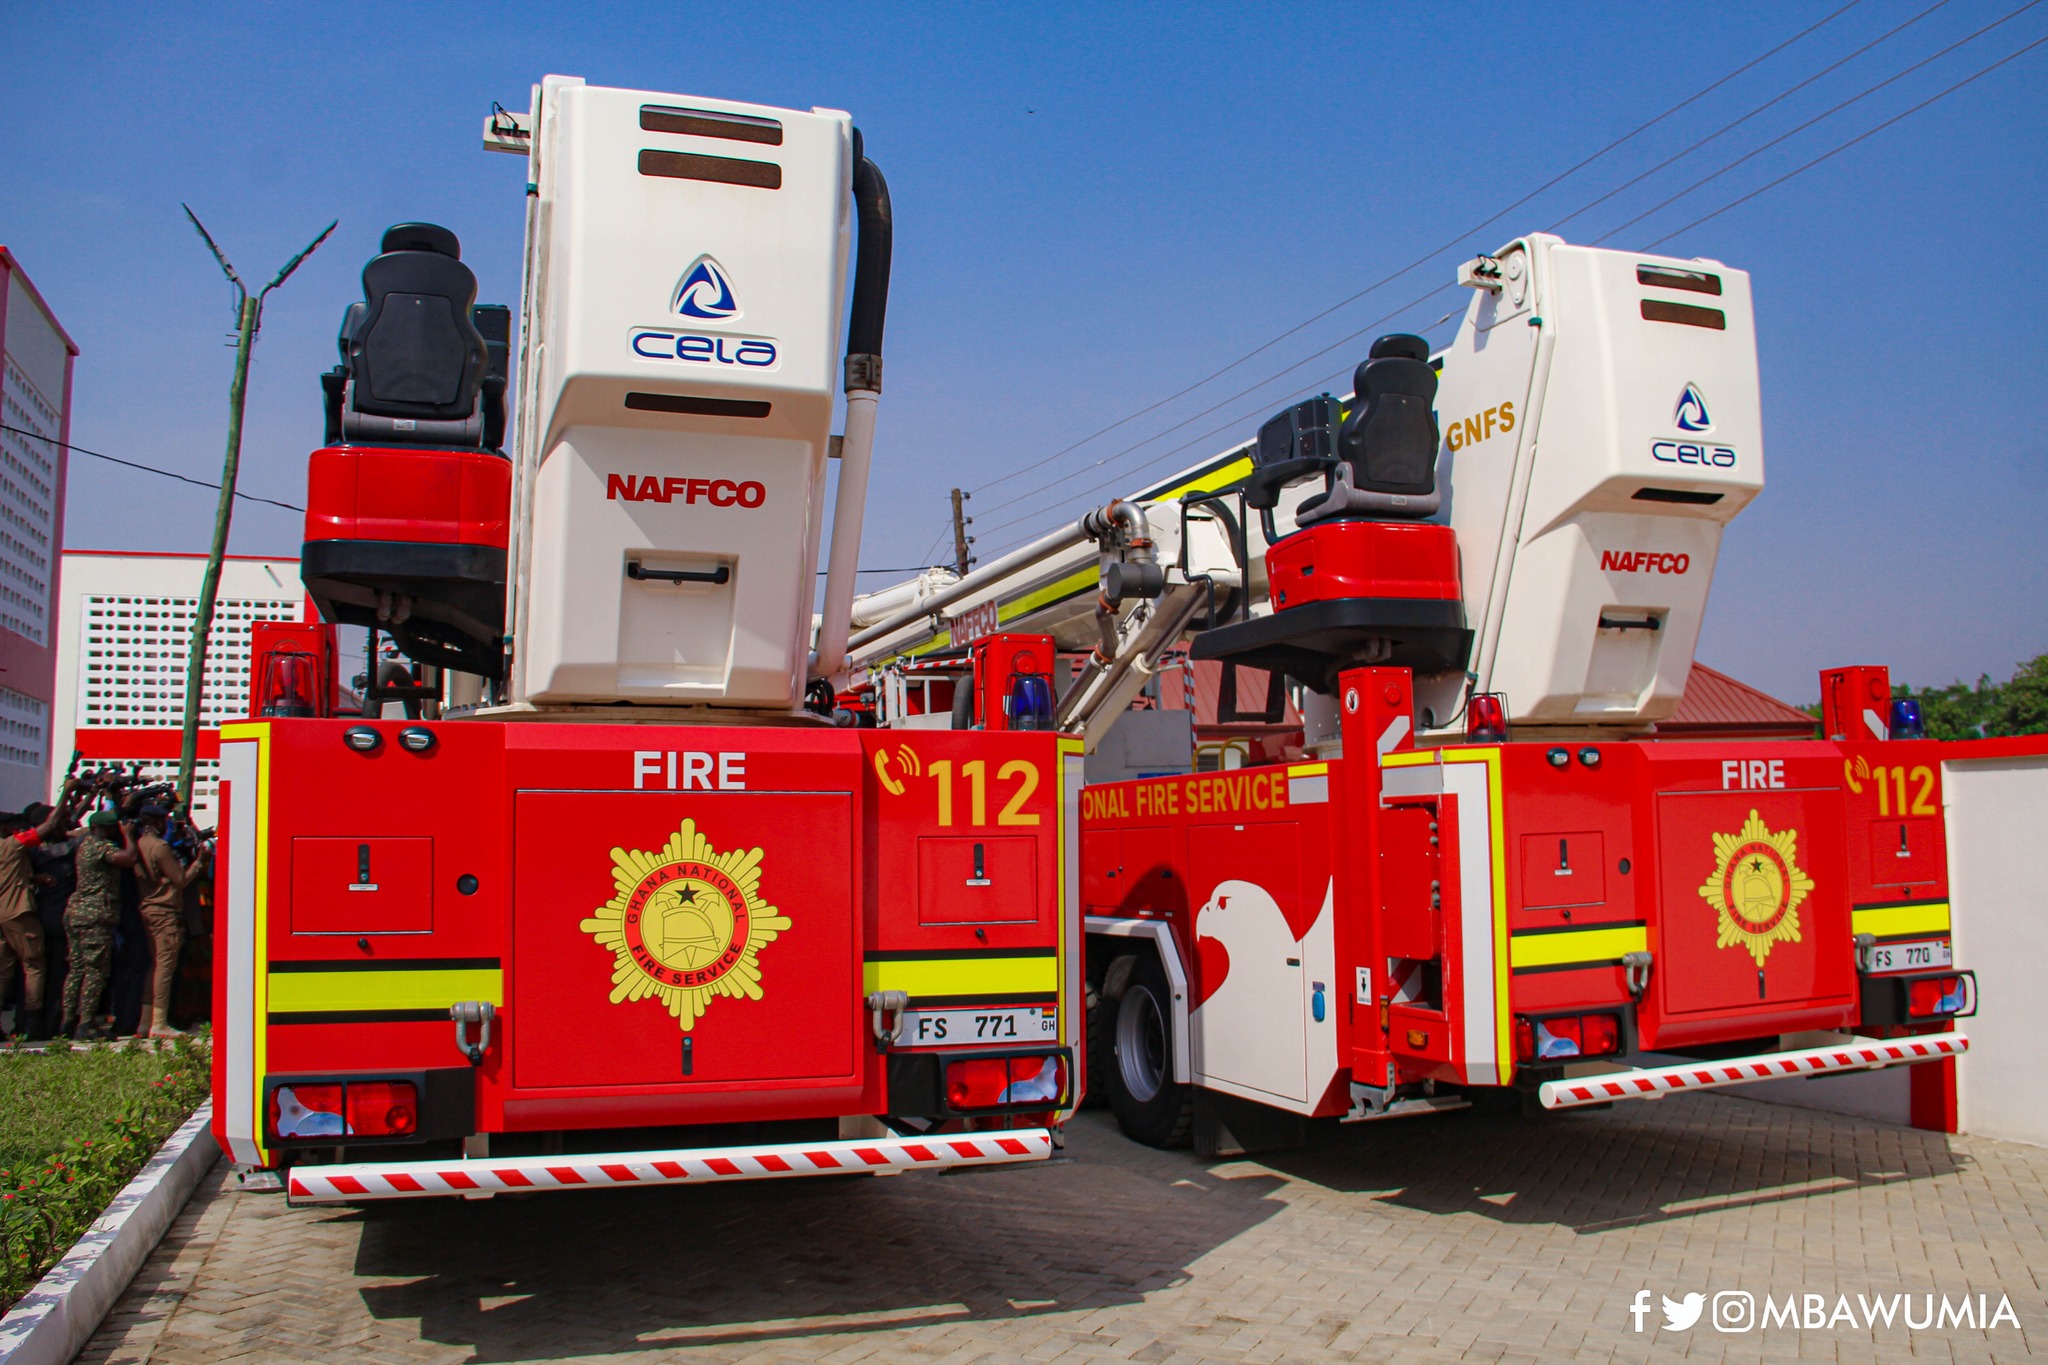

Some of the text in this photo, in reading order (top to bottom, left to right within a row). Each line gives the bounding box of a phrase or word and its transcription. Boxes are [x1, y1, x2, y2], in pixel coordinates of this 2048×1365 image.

[632, 332, 776, 366] cela
[1446, 401, 1515, 452] GNFS
[1652, 442, 1736, 468] cela
[606, 473, 766, 508] NAFFCO
[1600, 550, 1690, 574] NAFFCO
[950, 599, 996, 648] NAFFCO
[633, 751, 746, 789] FIRE
[1722, 760, 1785, 789] FIRE
[928, 760, 1040, 826] 112
[1136, 782, 1179, 816] FIRE
[1185, 772, 1285, 814] SERVICE
[1873, 766, 1936, 816] 112
[627, 865, 746, 924] GHANA NATIONAL
[632, 942, 742, 985] FIRE SERVICE
[1876, 947, 1930, 967] FS 770
[918, 1015, 1017, 1039] FS 771
[1041, 1019, 1055, 1031] GH
